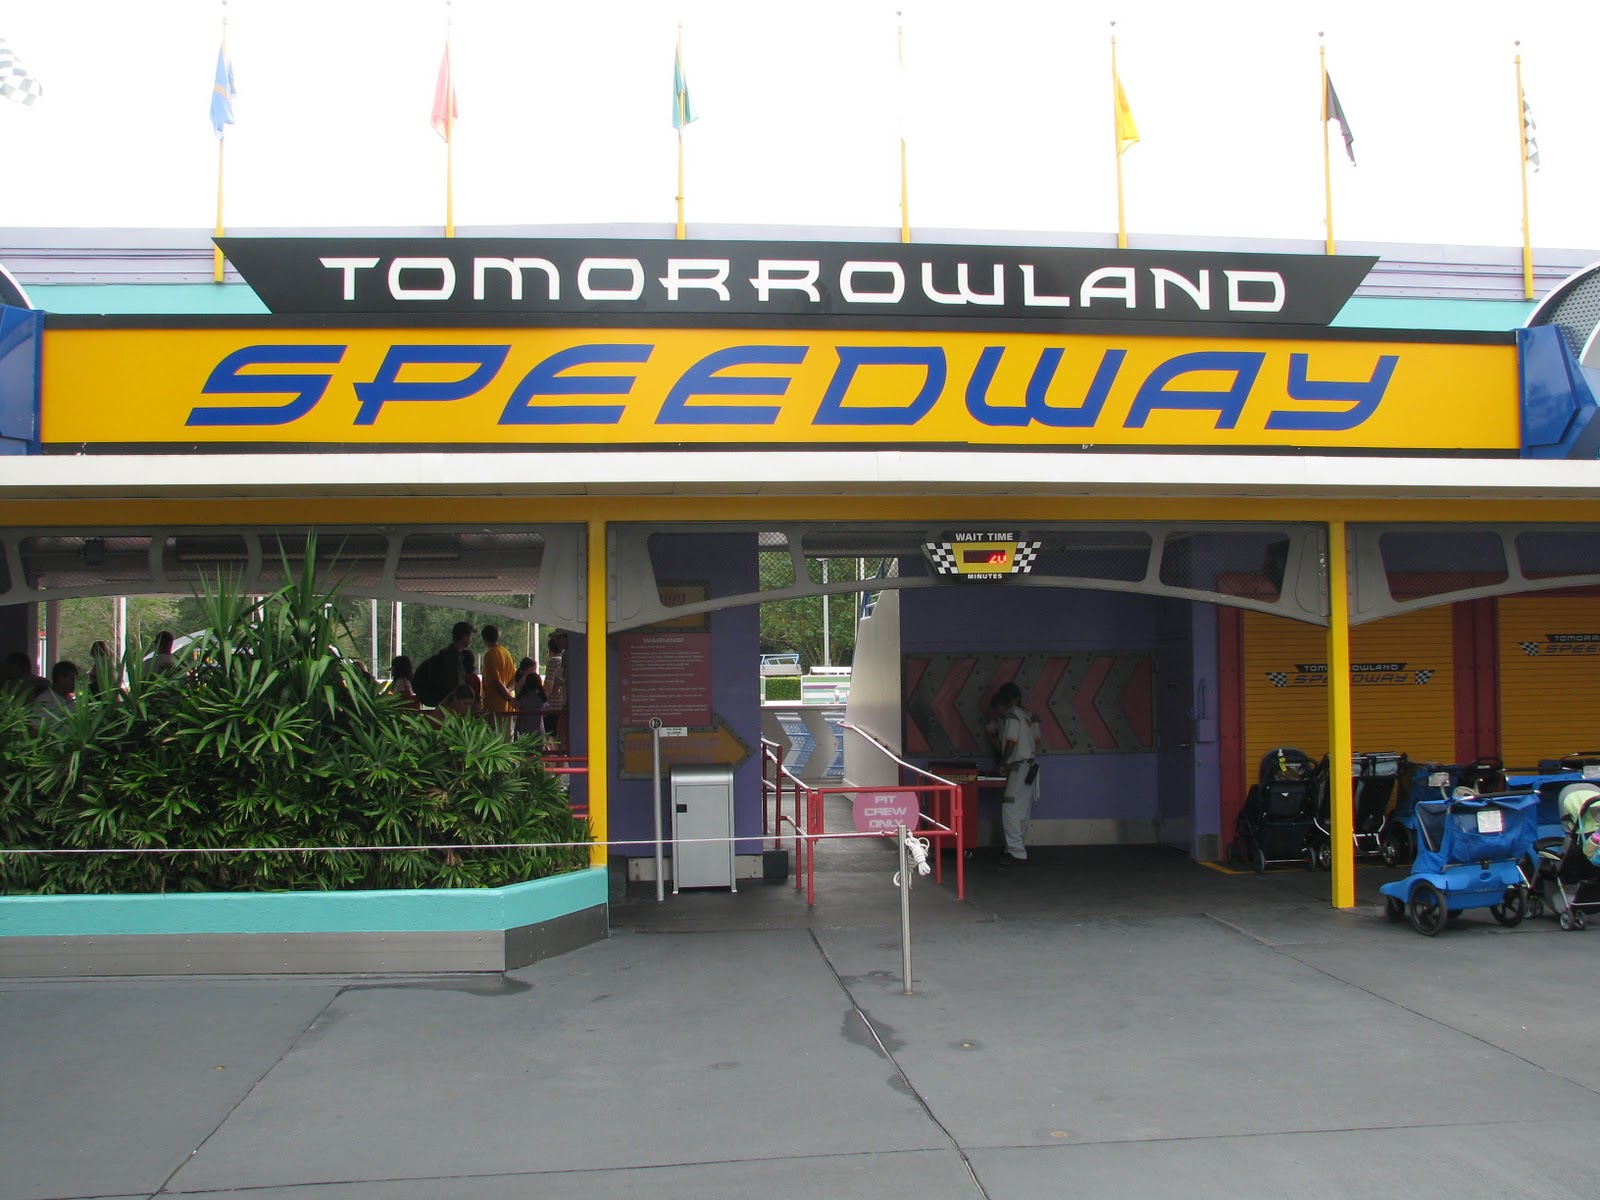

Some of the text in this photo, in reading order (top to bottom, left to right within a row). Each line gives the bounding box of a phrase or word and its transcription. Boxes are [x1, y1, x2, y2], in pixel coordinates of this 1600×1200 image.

[319, 256, 1287, 313] TOMORROWLAND
[184, 343, 1400, 431] SPEEDWAY
[955, 532, 1013, 541] WAIT TIME
[1546, 644, 1600, 653] SPEE
[875, 795, 896, 804] PIT
[865, 807, 906, 816] CREW
[869, 819, 903, 828] ONLY
